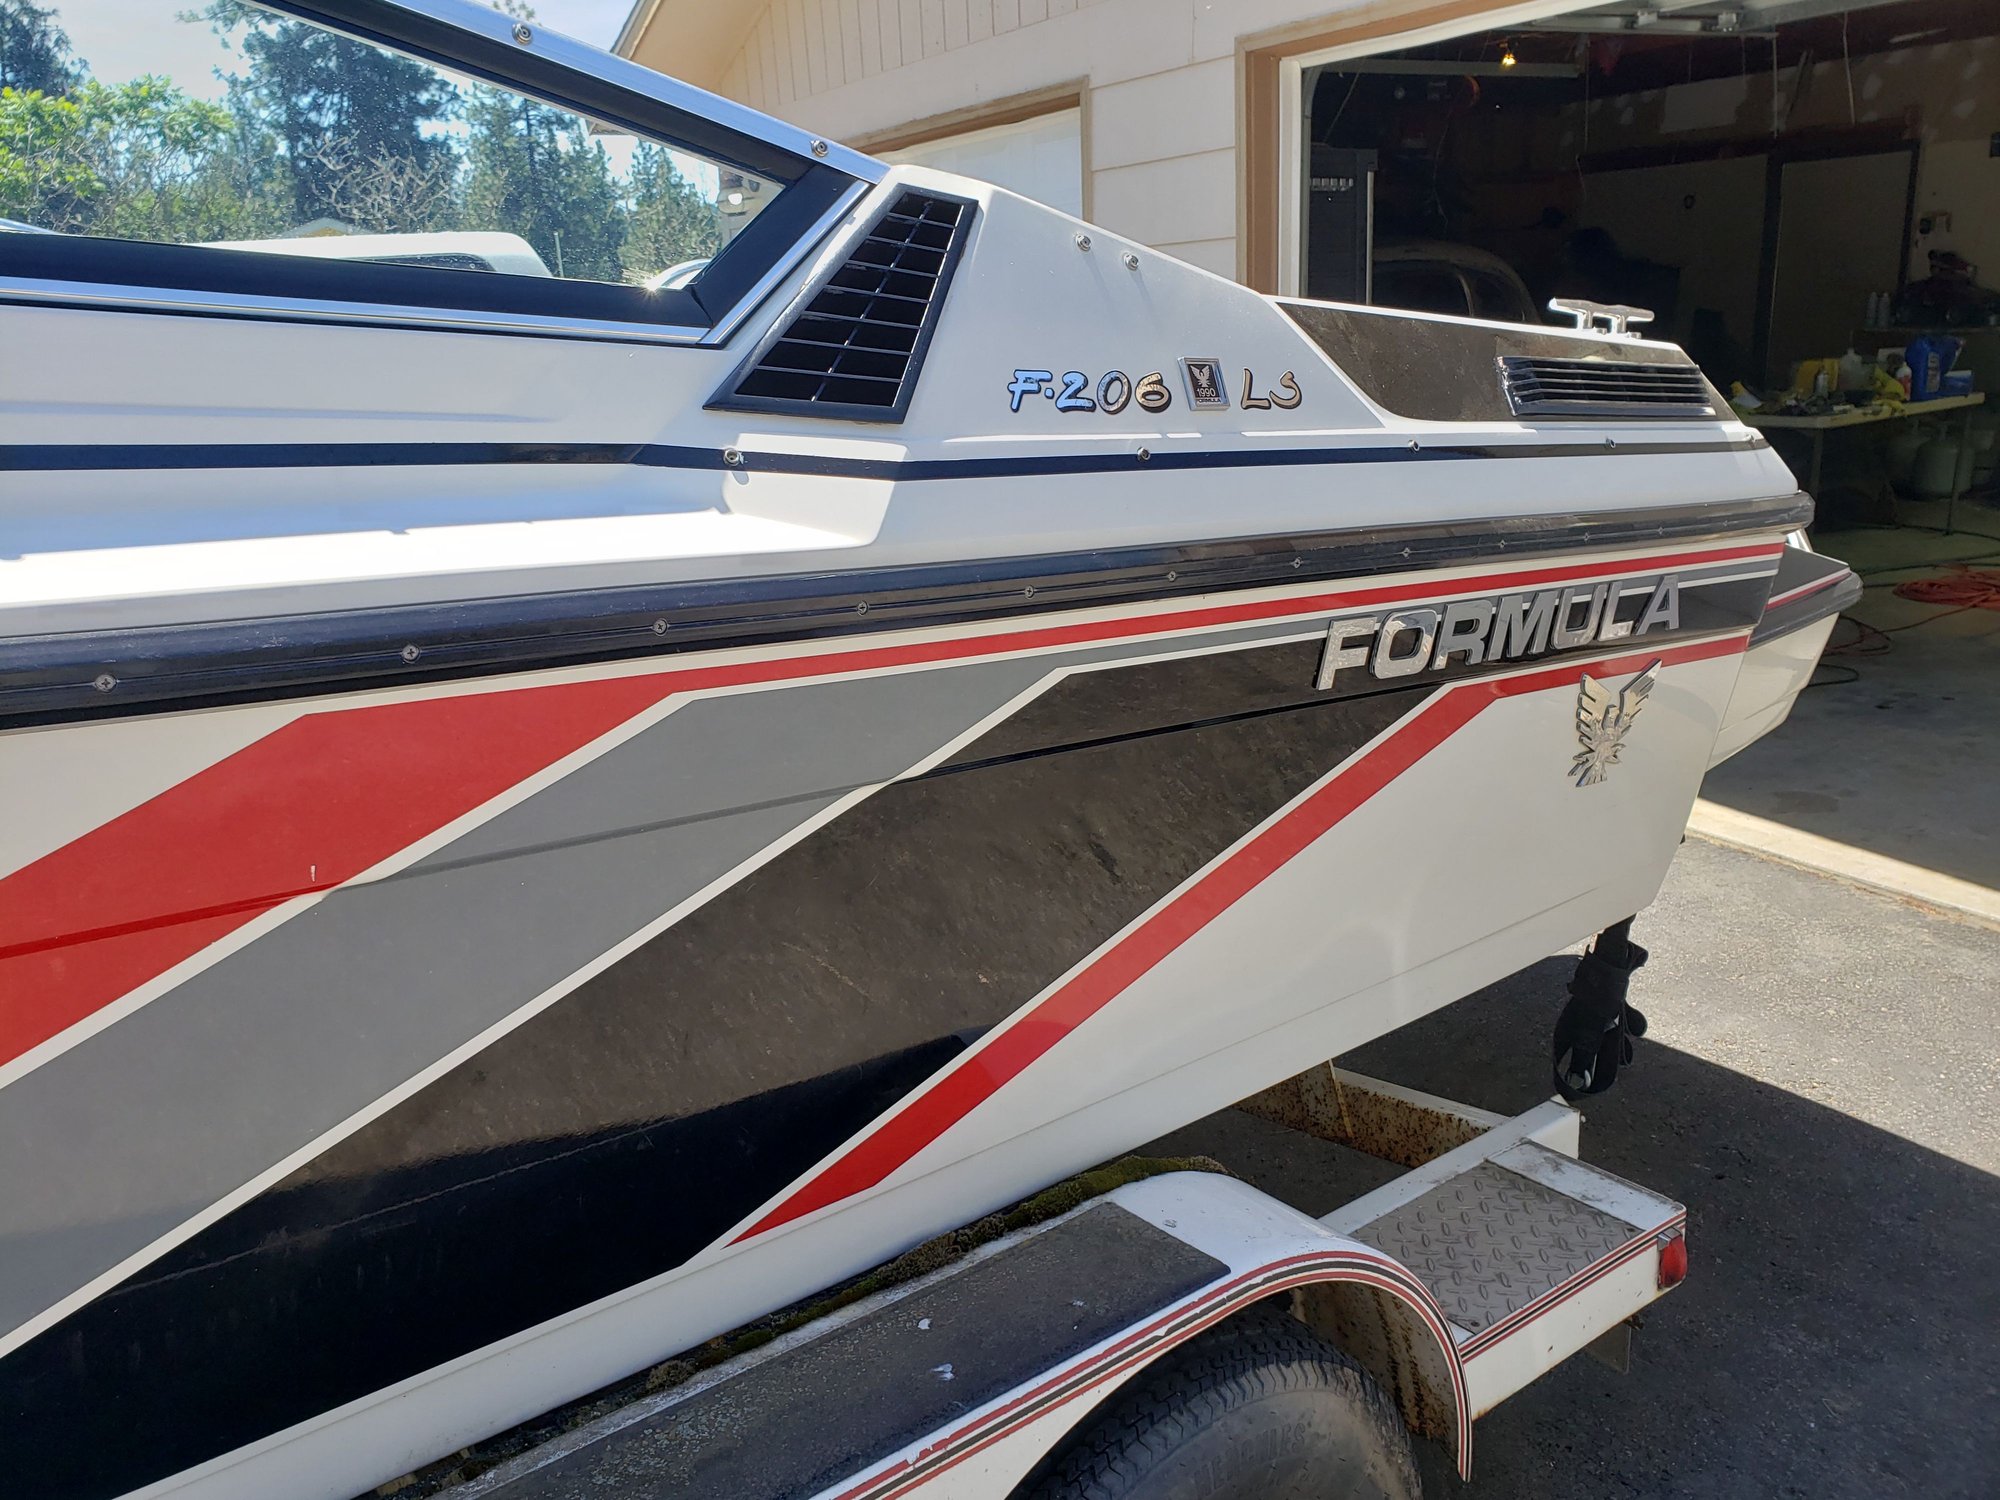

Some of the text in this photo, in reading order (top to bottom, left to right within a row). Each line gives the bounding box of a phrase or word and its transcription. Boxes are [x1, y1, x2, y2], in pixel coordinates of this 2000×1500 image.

[1197, 387, 1216, 398] 1990
[1240, 367, 1303, 411] LS
[1312, 574, 1680, 691] FORMULA
